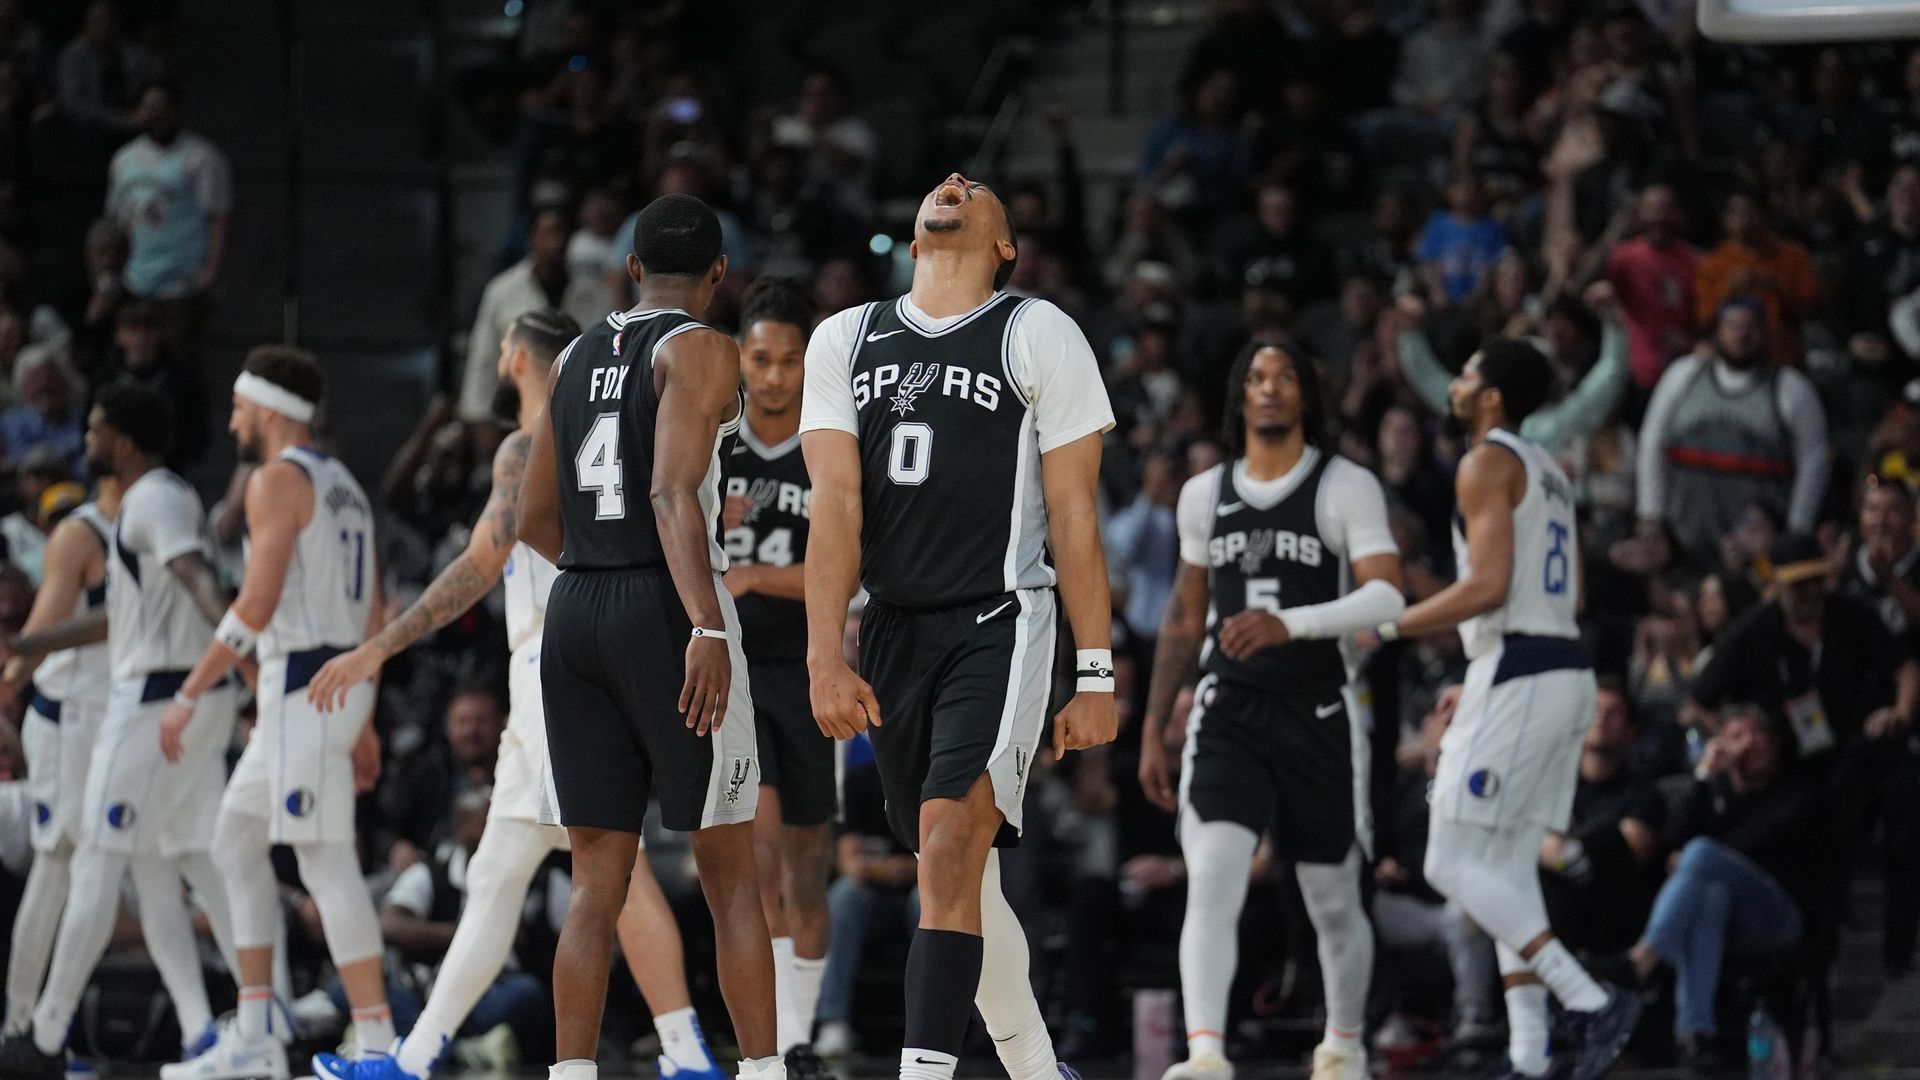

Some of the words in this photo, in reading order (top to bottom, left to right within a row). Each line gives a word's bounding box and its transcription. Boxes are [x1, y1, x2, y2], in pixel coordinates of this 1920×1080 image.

[589, 365, 630, 402] FOX
[852, 362, 1001, 416] SPURS
[575, 411, 625, 521] 4
[888, 422, 934, 485] 0
[726, 476, 811, 521] PUR
[724, 526, 793, 567] 24
[1208, 528, 1322, 573] SPURS
[1246, 578, 1280, 612] 5
